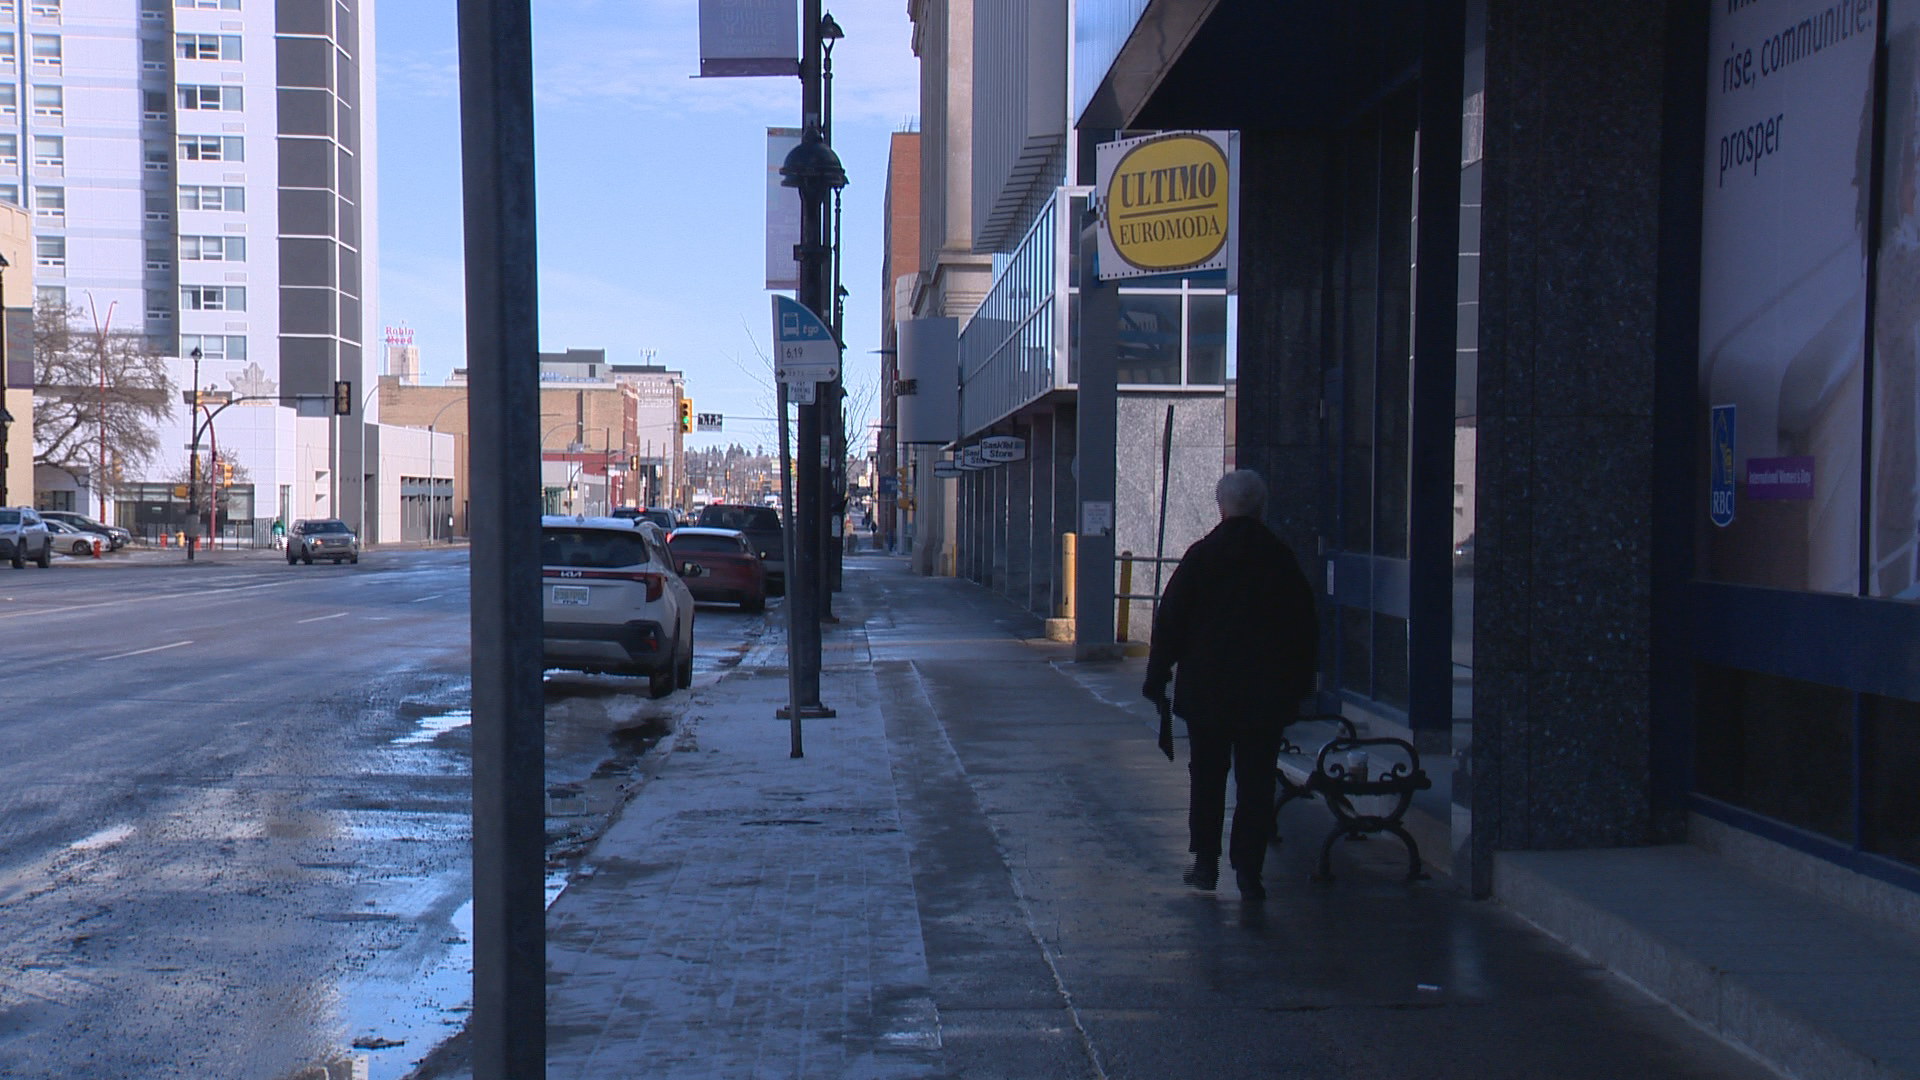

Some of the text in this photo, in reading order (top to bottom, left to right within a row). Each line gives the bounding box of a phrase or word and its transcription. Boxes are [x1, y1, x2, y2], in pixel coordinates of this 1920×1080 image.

[1723, 42, 1756, 94] rise,
[1719, 113, 1784, 188] prosper
[1120, 161, 1217, 208] ULTIMO
[1119, 215, 1221, 245] EUROMODA
[385, 326, 414, 335] Robin
[989, 449, 1014, 458] Store
[1713, 491, 1732, 514] RBC
